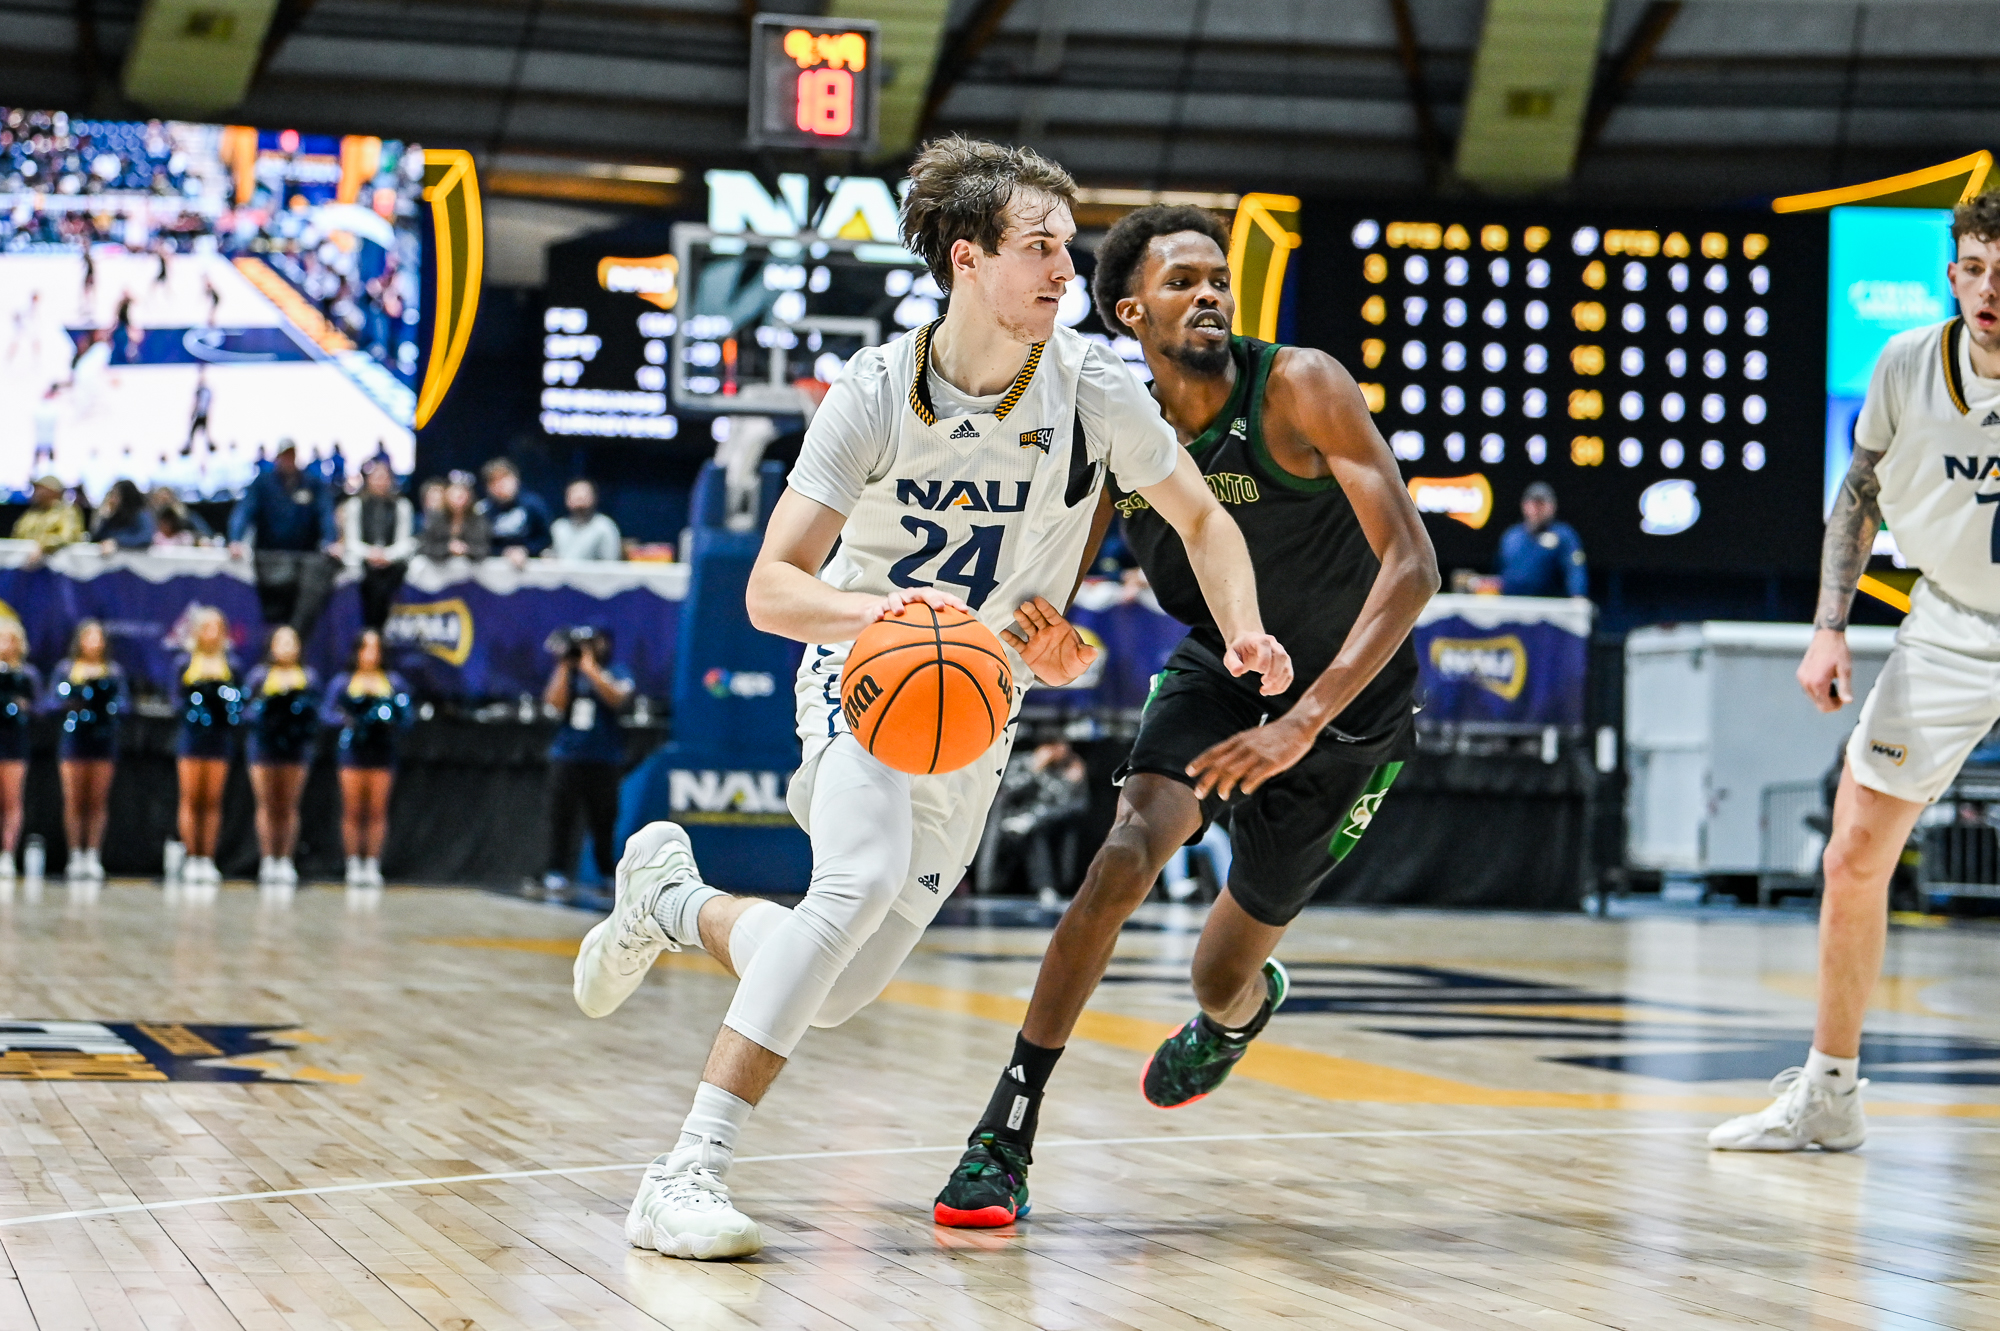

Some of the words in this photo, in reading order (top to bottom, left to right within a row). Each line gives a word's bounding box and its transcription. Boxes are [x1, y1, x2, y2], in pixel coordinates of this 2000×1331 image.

[797, 68, 854, 136] 18
[704, 168, 912, 262] NA
[949, 430, 980, 440] adidas
[895, 478, 1032, 513] NAU
[887, 514, 1006, 612] 24
